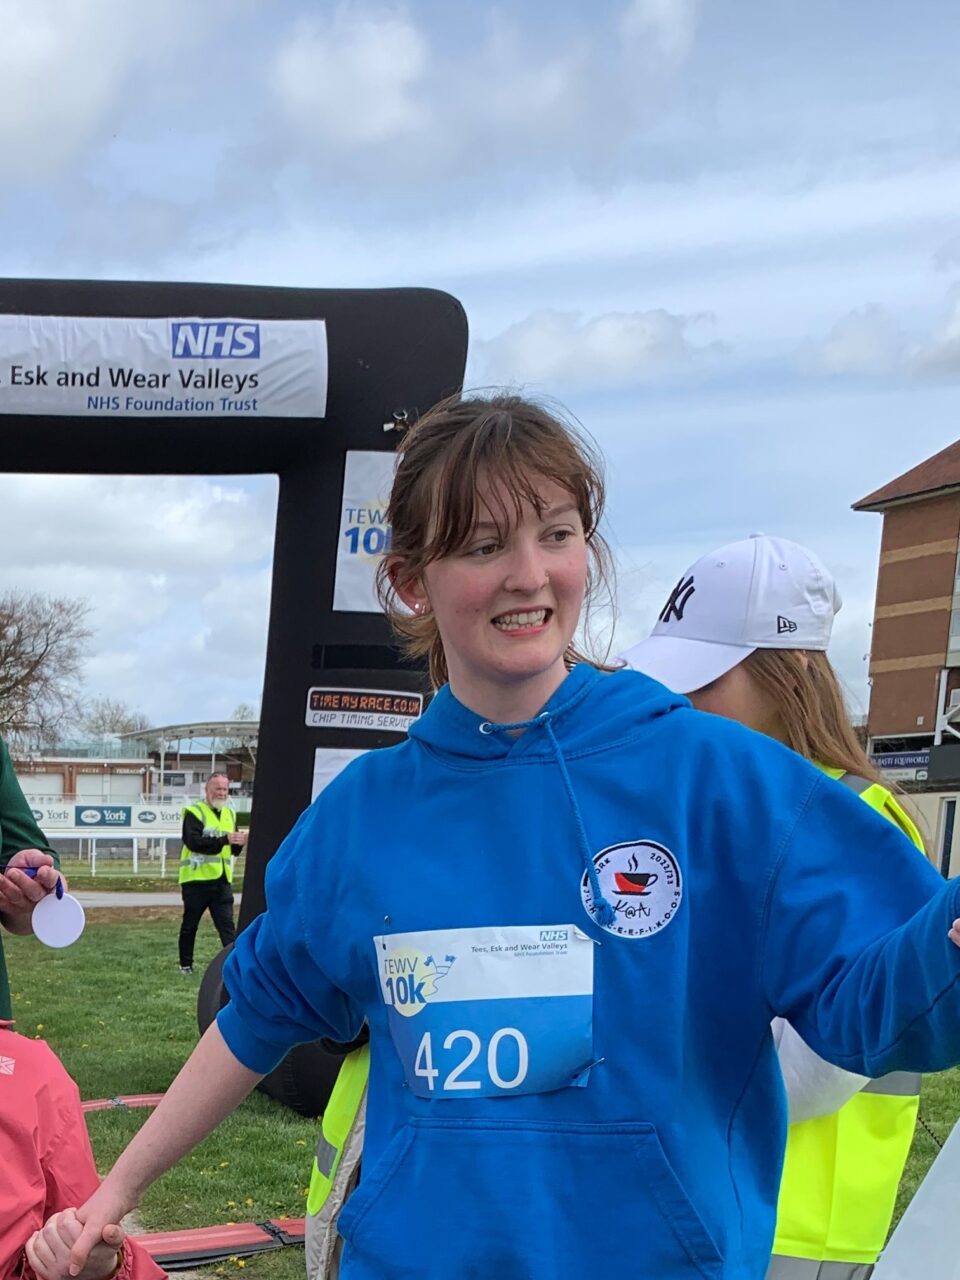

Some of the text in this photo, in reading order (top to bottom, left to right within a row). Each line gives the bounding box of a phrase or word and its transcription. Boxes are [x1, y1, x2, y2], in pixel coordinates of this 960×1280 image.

[175, 323, 258, 356] NHS
[10, 365, 48, 387] Esk
[56, 366, 100, 388] and
[108, 368, 171, 389] Wear
[178, 368, 259, 393] Valleys
[87, 396, 258, 411] NHS Foundation Trust
[311, 712, 337, 724] CHIP
[339, 714, 375, 727] TIMING
[46, 809, 70, 821] York
[103, 810, 127, 821] York
[541, 931, 567, 941] NHS
[471, 946, 489, 954] Tees,
[505, 944, 519, 952] and
[520, 943, 540, 951] Wear
[542, 942, 568, 950] Valleys
[384, 957, 419, 975] TEWV
[385, 973, 427, 1006] 10k
[414, 1027, 529, 1091] 420
